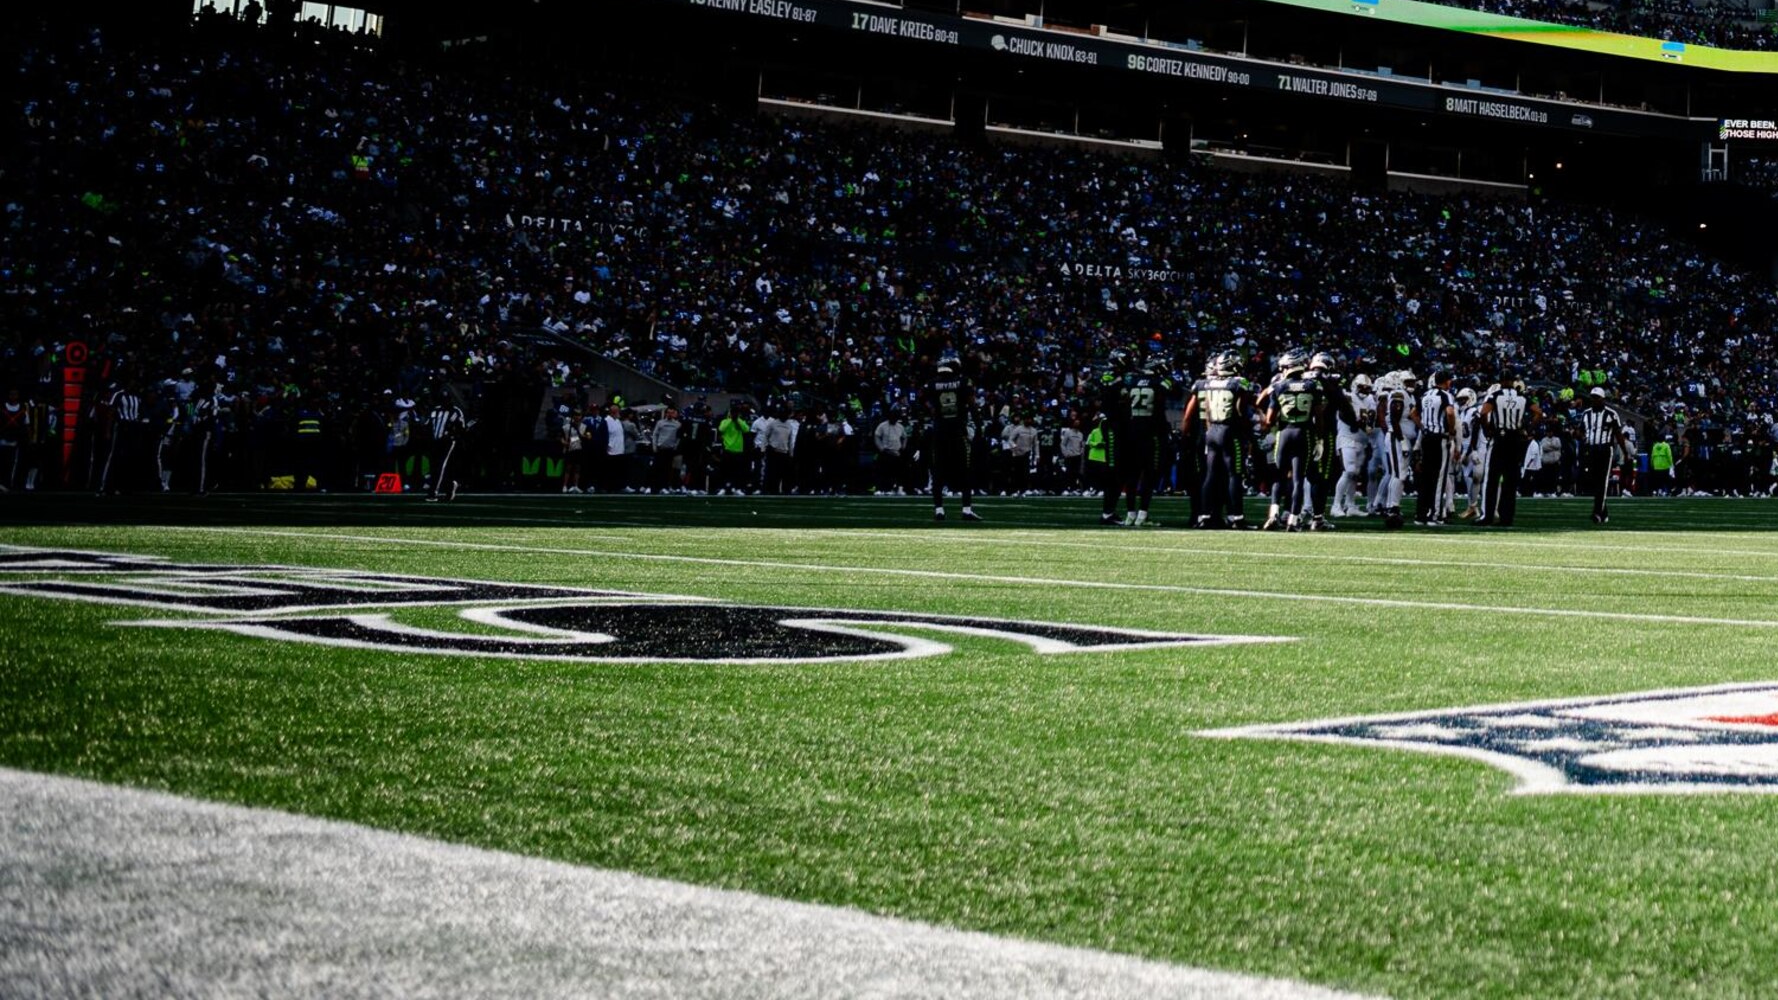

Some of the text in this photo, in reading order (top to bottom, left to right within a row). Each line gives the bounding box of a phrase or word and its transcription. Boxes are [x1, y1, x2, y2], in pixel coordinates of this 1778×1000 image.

[851, 12, 959, 45] 17 DAVE KRIEG 80-91
[1009, 37, 1044, 58] CHUCK
[1046, 43, 1075, 62] KNOX
[1127, 53, 1145, 71] 96
[1146, 56, 1183, 77] CORTEZ
[1184, 61, 1228, 83] KENNEDY
[1278, 74, 1292, 90] 71
[1292, 77, 1327, 97] WALTER
[1329, 82, 1357, 101] JONES
[1446, 97, 1454, 111] 8
[1454, 99, 1478, 116] MATT
[1478, 101, 1531, 122] HASSELBECK
[1724, 119, 1748, 129] EVER
[1750, 120, 1777, 130] BEEN,
[1727, 130, 1754, 139] THOSE
[1075, 263, 1121, 278] DELTA
[1130, 388, 1154, 417] 23
[1279, 393, 1313, 422] 29
